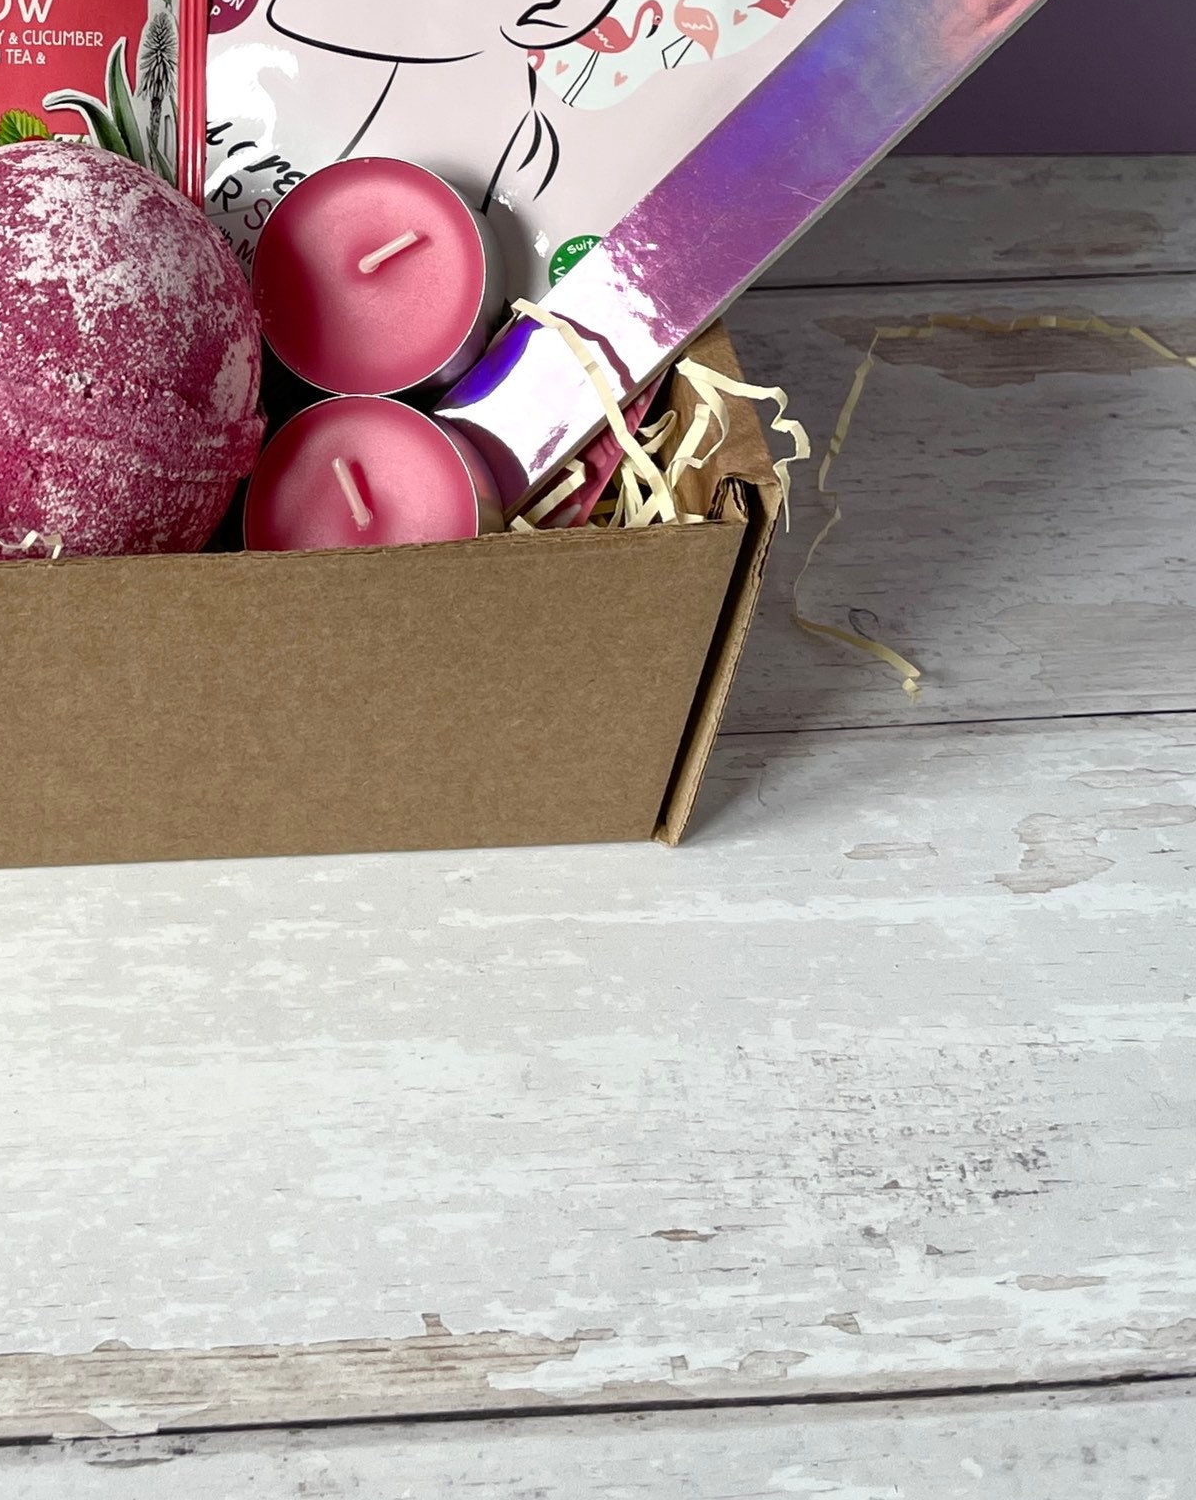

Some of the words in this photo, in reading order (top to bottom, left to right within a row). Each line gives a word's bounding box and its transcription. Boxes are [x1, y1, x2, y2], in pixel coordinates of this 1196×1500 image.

[8, 31, 19, 46] &
[21, 29, 104, 47] CUCUMBER
[4, 48, 33, 66] TEA
[35, 51, 47, 66] &
